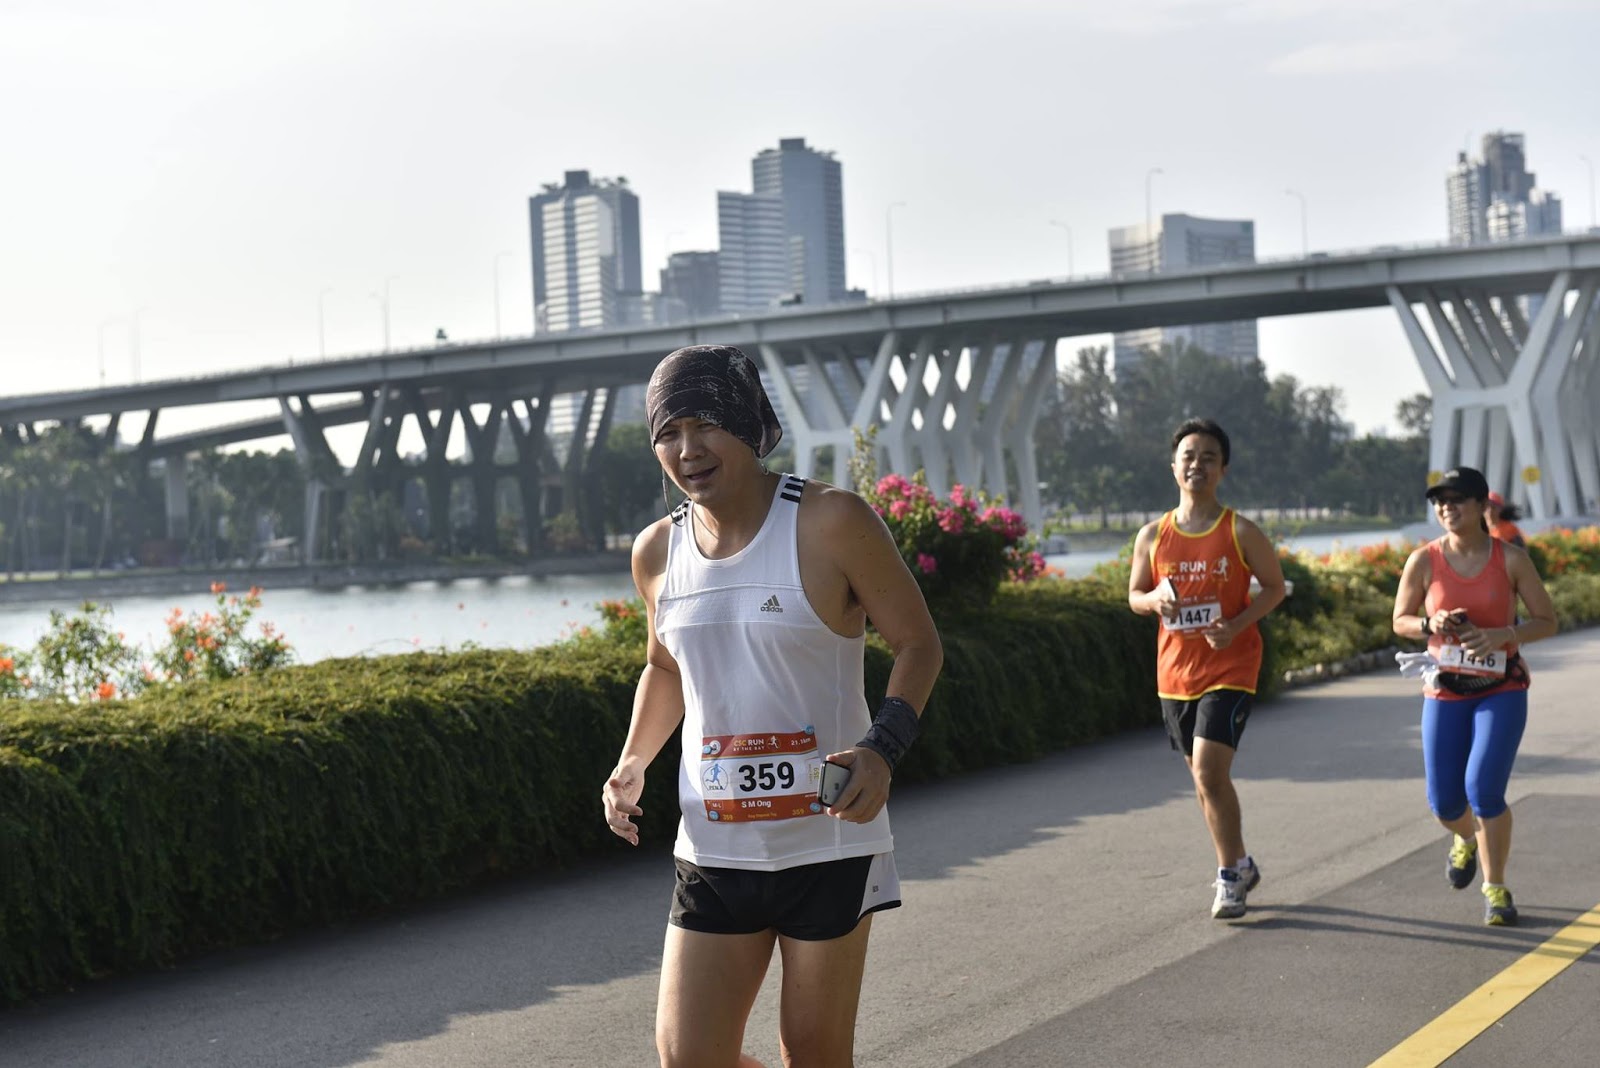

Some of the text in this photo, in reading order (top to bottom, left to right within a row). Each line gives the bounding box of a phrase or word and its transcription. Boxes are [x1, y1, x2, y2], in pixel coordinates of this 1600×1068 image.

[1180, 561, 1207, 573] RUN
[1179, 608, 1211, 625] 1447
[738, 761, 796, 793] 359
[741, 801, 747, 809] S
[756, 800, 772, 808] Ong
